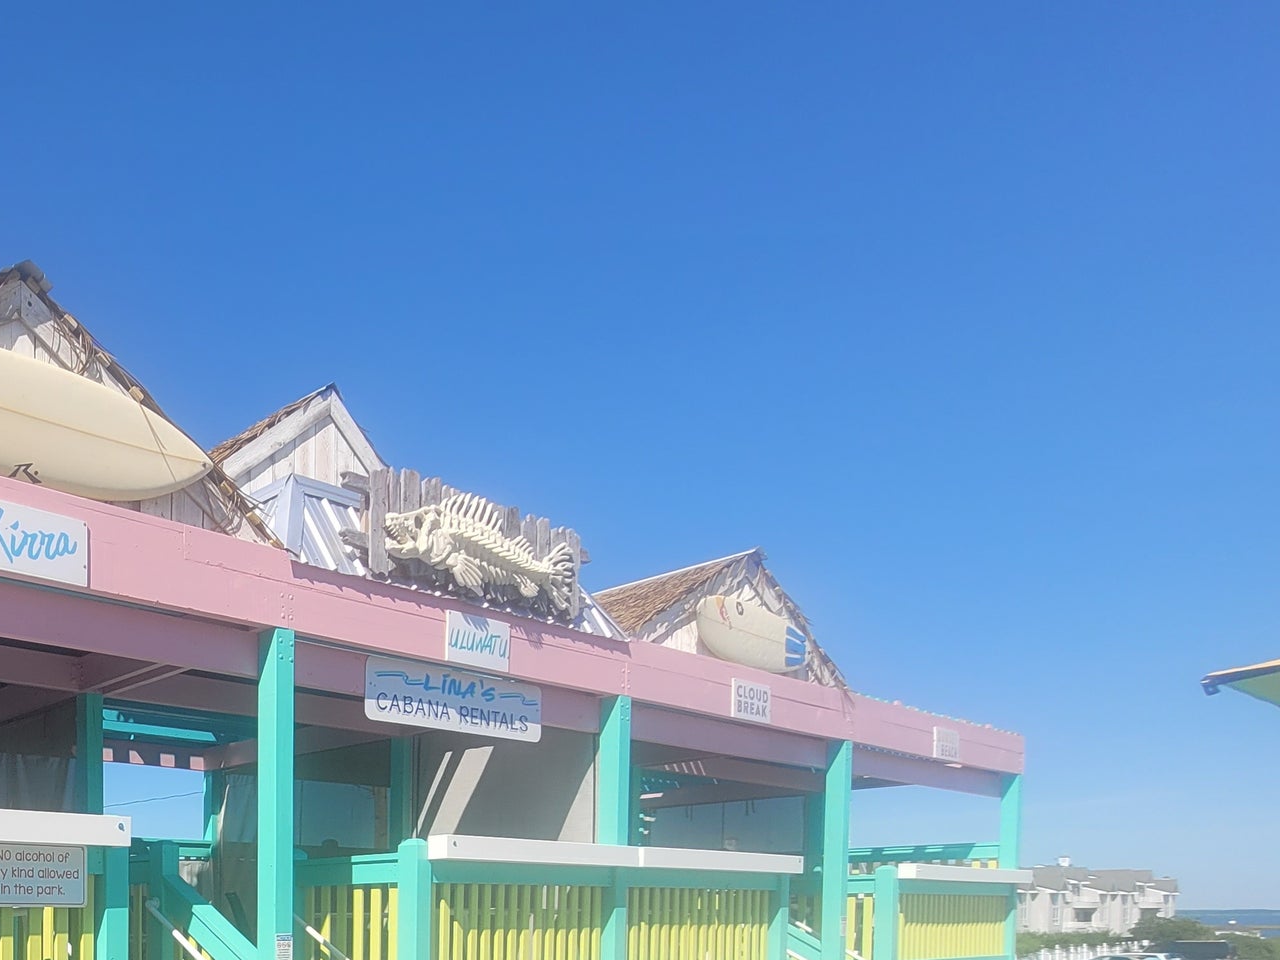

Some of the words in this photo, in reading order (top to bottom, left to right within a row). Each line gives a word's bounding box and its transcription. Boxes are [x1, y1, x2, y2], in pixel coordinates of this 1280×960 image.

[448, 627, 508, 660] ULUWATU
[736, 684, 769, 704] CLOUD
[376, 691, 451, 720] CABANA
[459, 705, 529, 732] RENTALS
[736, 699, 768, 718] BREAK
[15, 850, 55, 863] alcohol
[57, 852, 70, 863] of
[11, 867, 34, 878] kind
[37, 868, 79, 879] allowed
[14, 883, 33, 895] the
[36, 884, 66, 897] park.
